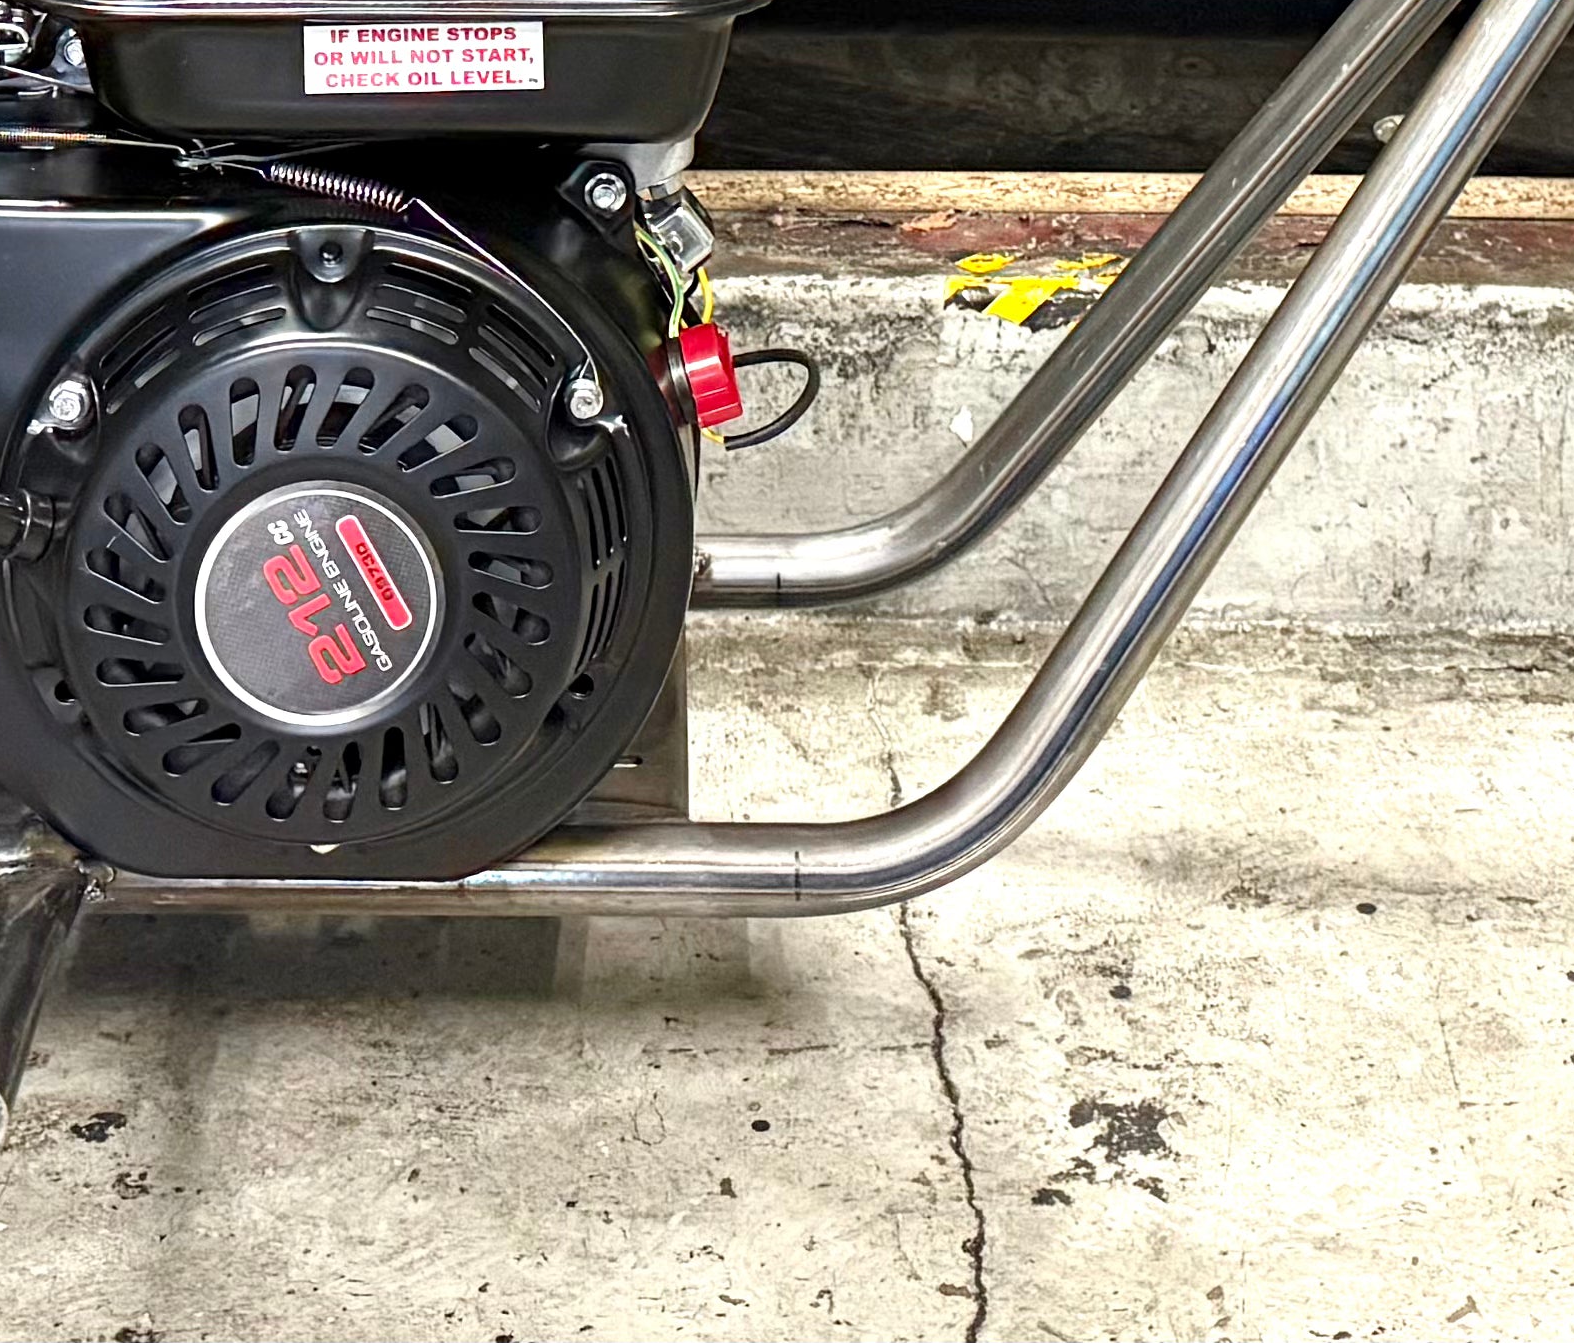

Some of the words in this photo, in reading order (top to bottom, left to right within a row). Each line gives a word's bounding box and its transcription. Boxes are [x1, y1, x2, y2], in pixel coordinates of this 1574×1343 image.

[314, 52, 343, 66] OR
[351, 50, 402, 65] WILL
[410, 49, 454, 63] NOT
[462, 48, 534, 63] START,
[330, 29, 349, 43] IF
[358, 28, 439, 42] ENGINE
[447, 27, 516, 42] STOPS
[326, 73, 399, 88] CHECK
[408, 72, 442, 85] OIL
[451, 70, 522, 85] LEVEL.
[294, 508, 340, 579] ENGINE
[263, 544, 367, 684] 212
[333, 578, 392, 672] GASOLINE
